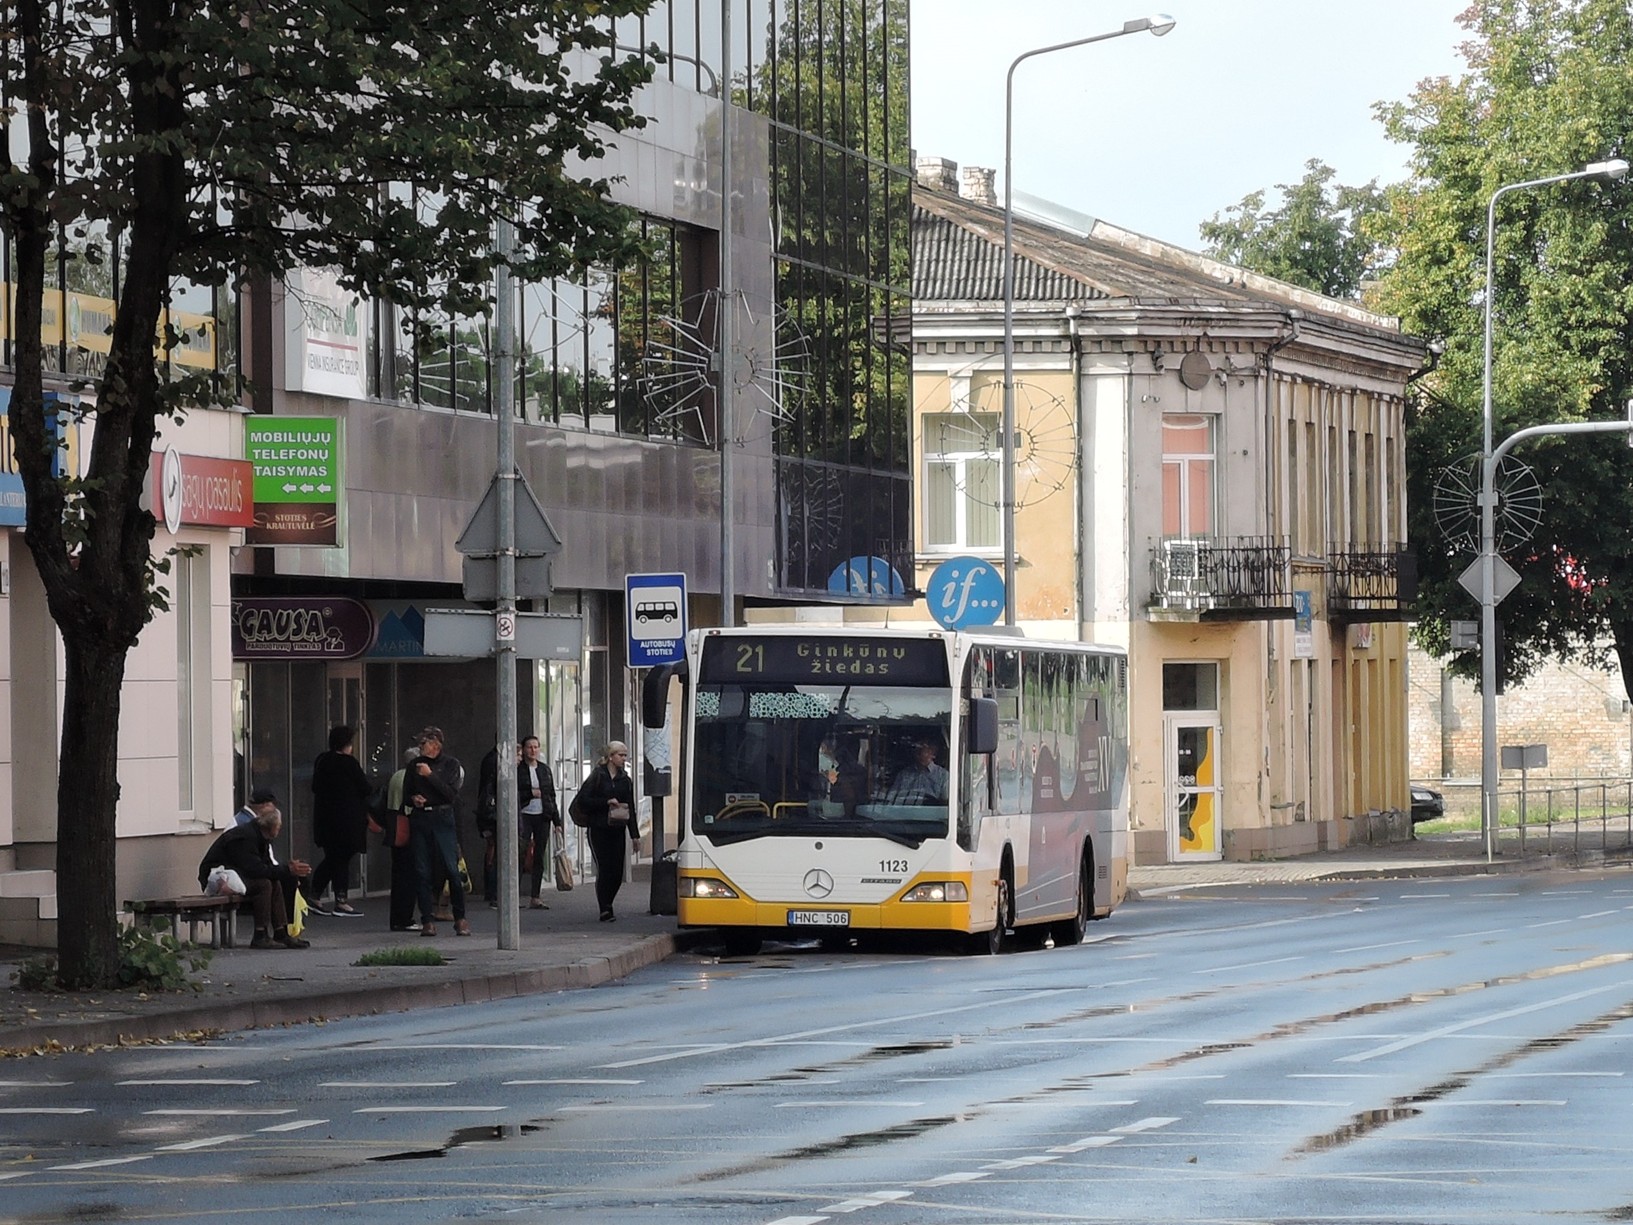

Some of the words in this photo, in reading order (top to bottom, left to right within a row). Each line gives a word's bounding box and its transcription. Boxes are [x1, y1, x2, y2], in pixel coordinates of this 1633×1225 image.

[345, 359, 359, 376] GROUP
[250, 432, 331, 445] MOBILIŲJŲ
[253, 449, 329, 462] TELEFONŲ
[254, 466, 328, 477] TAISYMAS
[206, 467, 243, 520] pasaulis
[275, 514, 307, 522] STOTIES
[240, 608, 326, 641] GAUSA
[736, 644, 765, 673] 21
[811, 659, 889, 674] žiedas
[879, 860, 908, 873] 1123
[795, 913, 819, 924] HNC
[826, 913, 847, 924] 506
